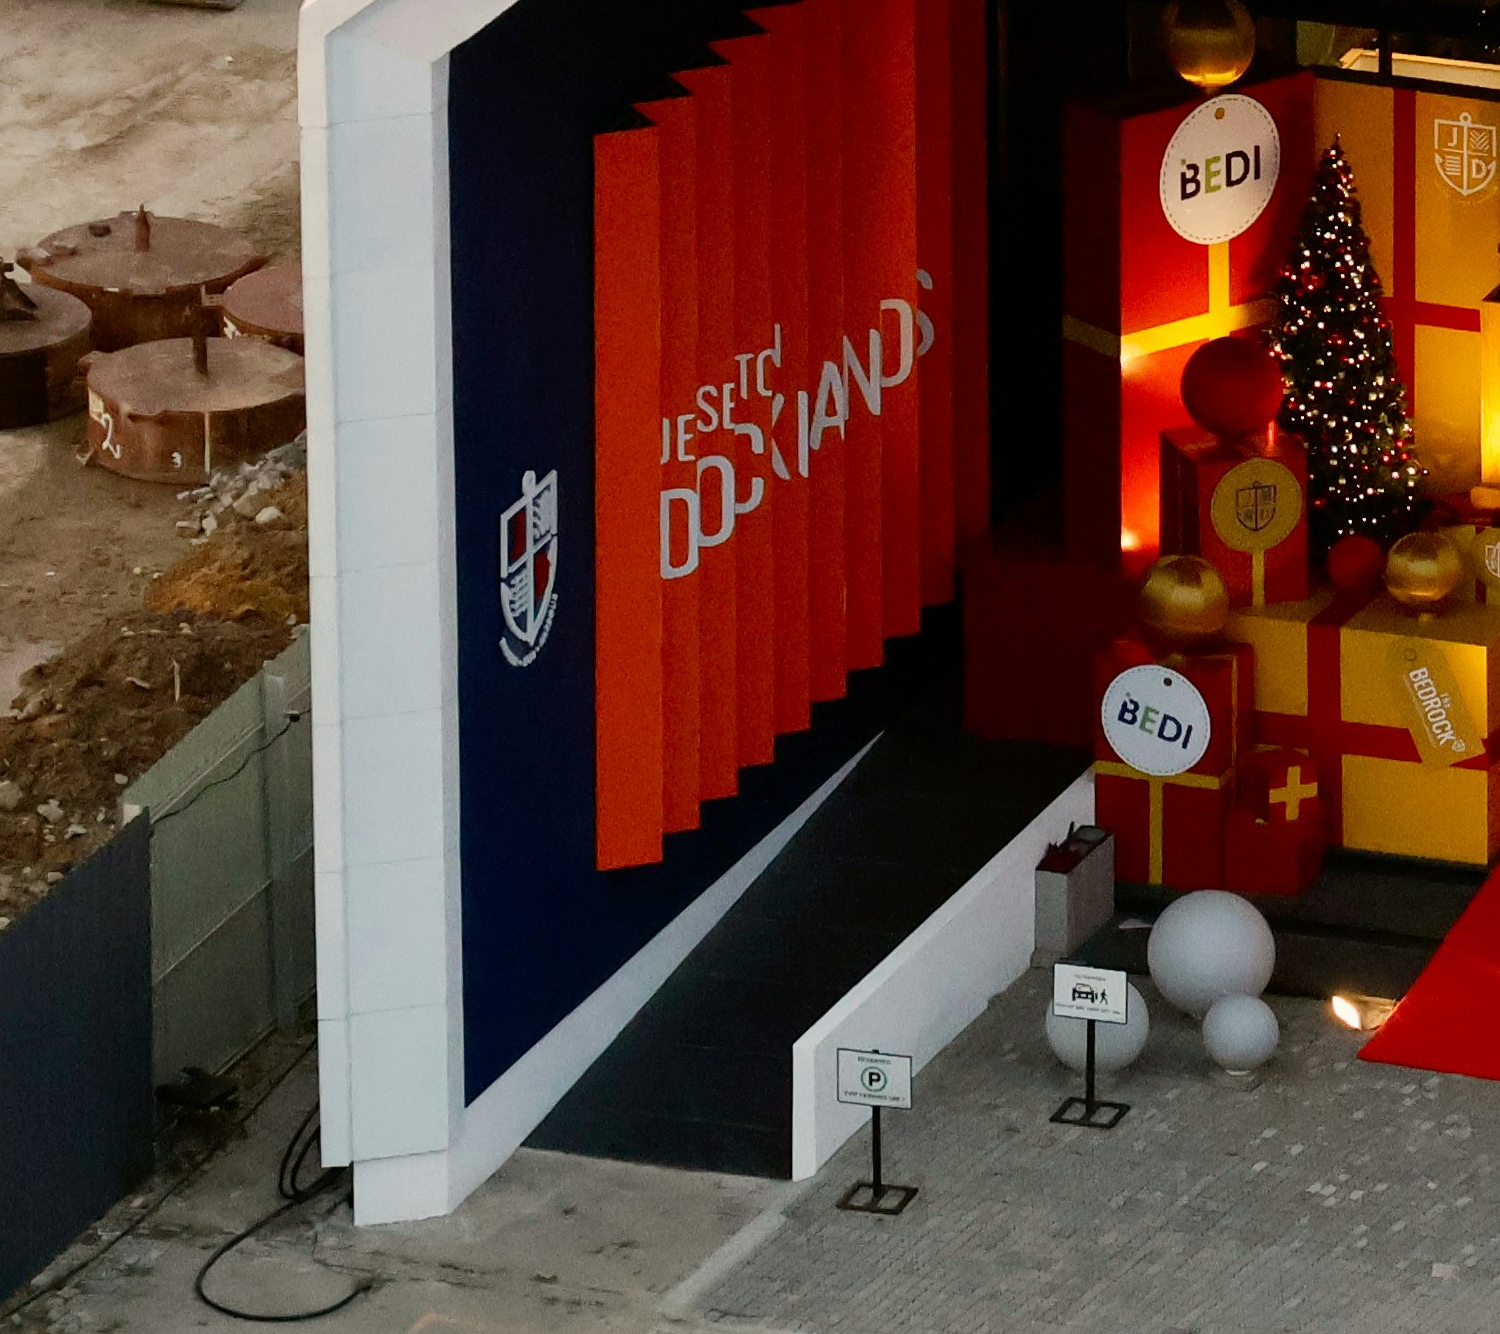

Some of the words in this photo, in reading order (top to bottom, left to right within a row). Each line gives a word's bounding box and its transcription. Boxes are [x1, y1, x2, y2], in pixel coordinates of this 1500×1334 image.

[1180, 145, 1261, 201] BEDI
[1117, 692, 1193, 749] BEDI
[1409, 667, 1457, 746] BEDROCK
[868, 1072, 881, 1087] P
